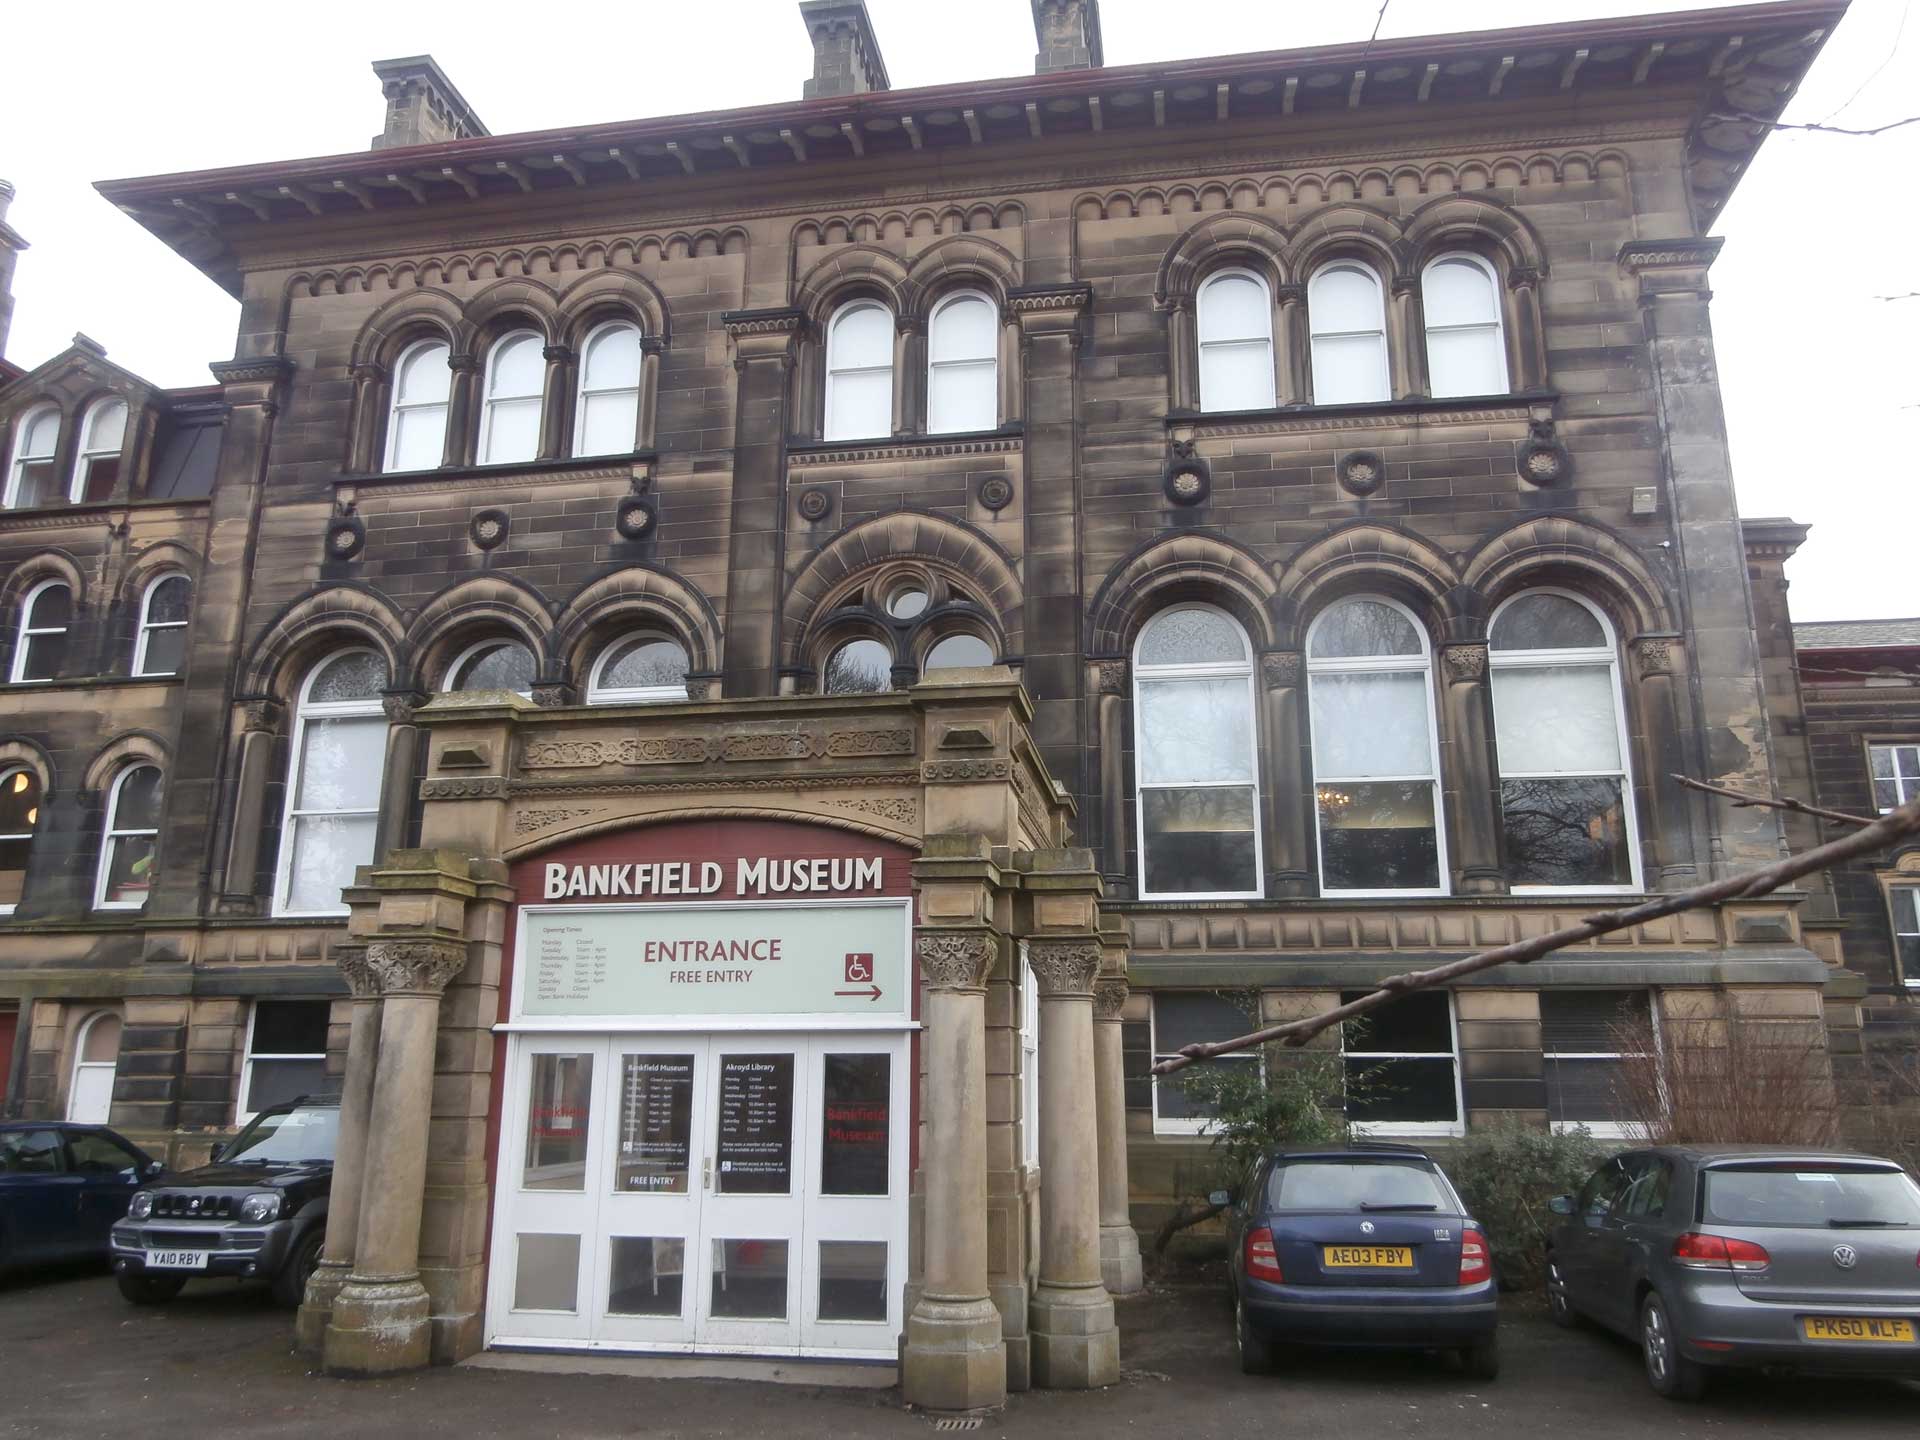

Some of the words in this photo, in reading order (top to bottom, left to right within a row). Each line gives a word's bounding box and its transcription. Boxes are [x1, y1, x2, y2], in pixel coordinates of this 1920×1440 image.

[543, 862, 723, 899] BANKFIELD
[736, 857, 883, 895] MUSEUM
[644, 939, 782, 963] ENTRANCE
[670, 971, 702, 983] FREE
[706, 970, 753, 983] ENTRY
[660, 1064, 689, 1072] Museum
[726, 1063, 750, 1073] Akroyd
[751, 1062, 775, 1073] Library
[828, 1106, 887, 1121] Bankfield
[829, 1128, 886, 1141] Museum
[630, 1176, 648, 1185] FREE
[649, 1176, 675, 1185] ENTRY
[153, 1252, 177, 1265] YA10
[179, 1252, 201, 1265] RBY
[1332, 1248, 1371, 1264] AE03
[1375, 1248, 1404, 1264] FBY
[1813, 1319, 1863, 1337] PK60
[1867, 1319, 1903, 1337] WLF
